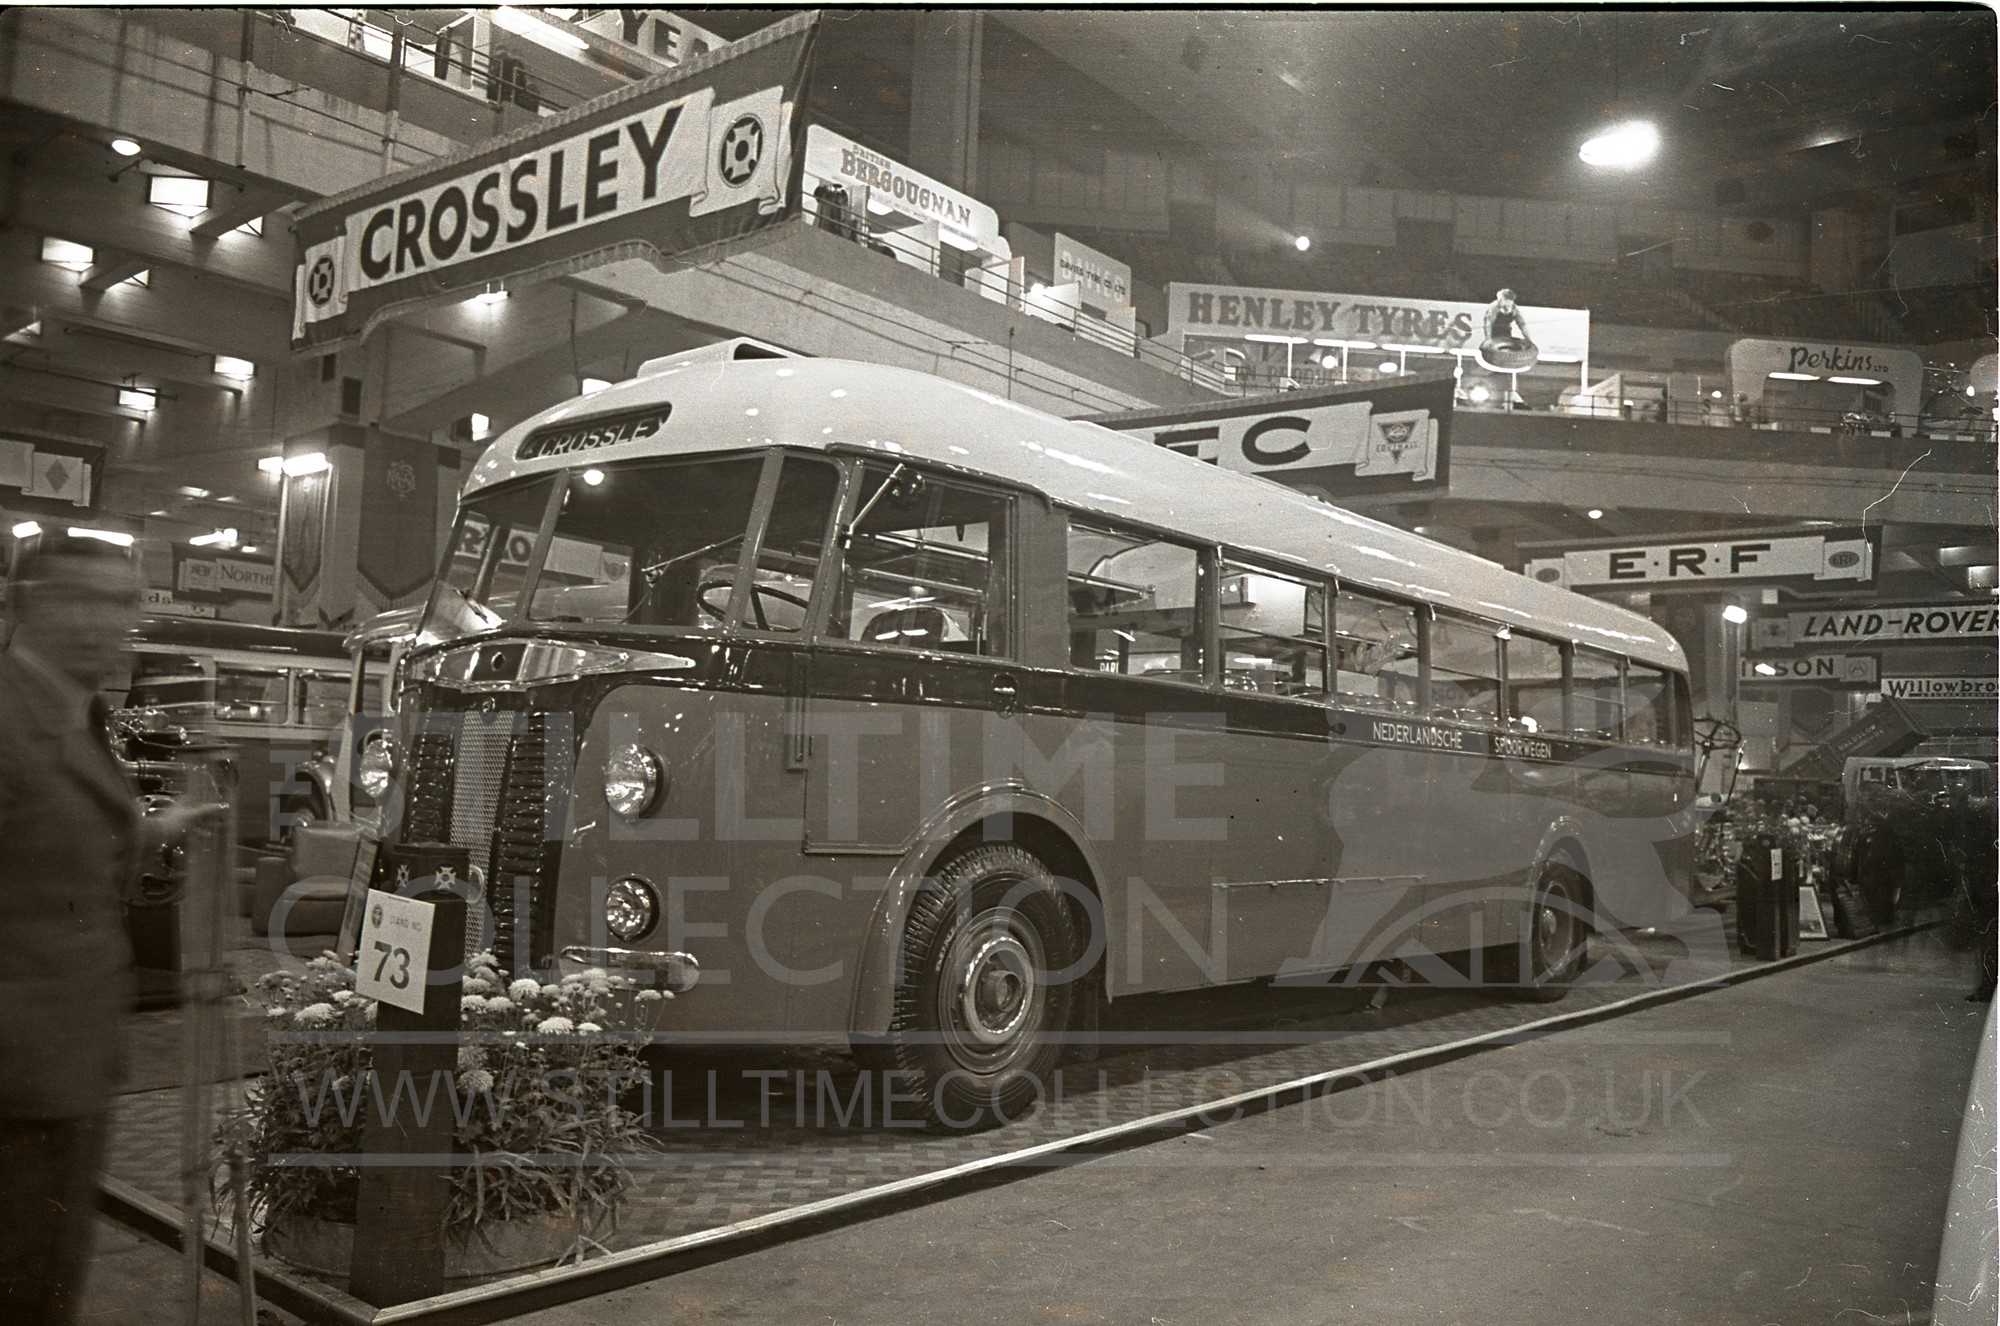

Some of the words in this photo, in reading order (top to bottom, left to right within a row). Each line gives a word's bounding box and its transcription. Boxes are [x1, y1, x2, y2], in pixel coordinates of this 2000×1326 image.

[361, 106, 683, 281] CROSSLEY
[840, 148, 971, 228] BERGOUGNAN
[1187, 291, 1341, 332] HENLEY
[1352, 303, 1473, 341] TYRES
[1787, 346, 1872, 373] Perkins
[1154, 416, 1312, 467] EC
[1373, 721, 1463, 750] NEDERLANDSCHE
[1494, 736, 1552, 759] SPOORWEGEN
[373, 941, 411, 990] 73
